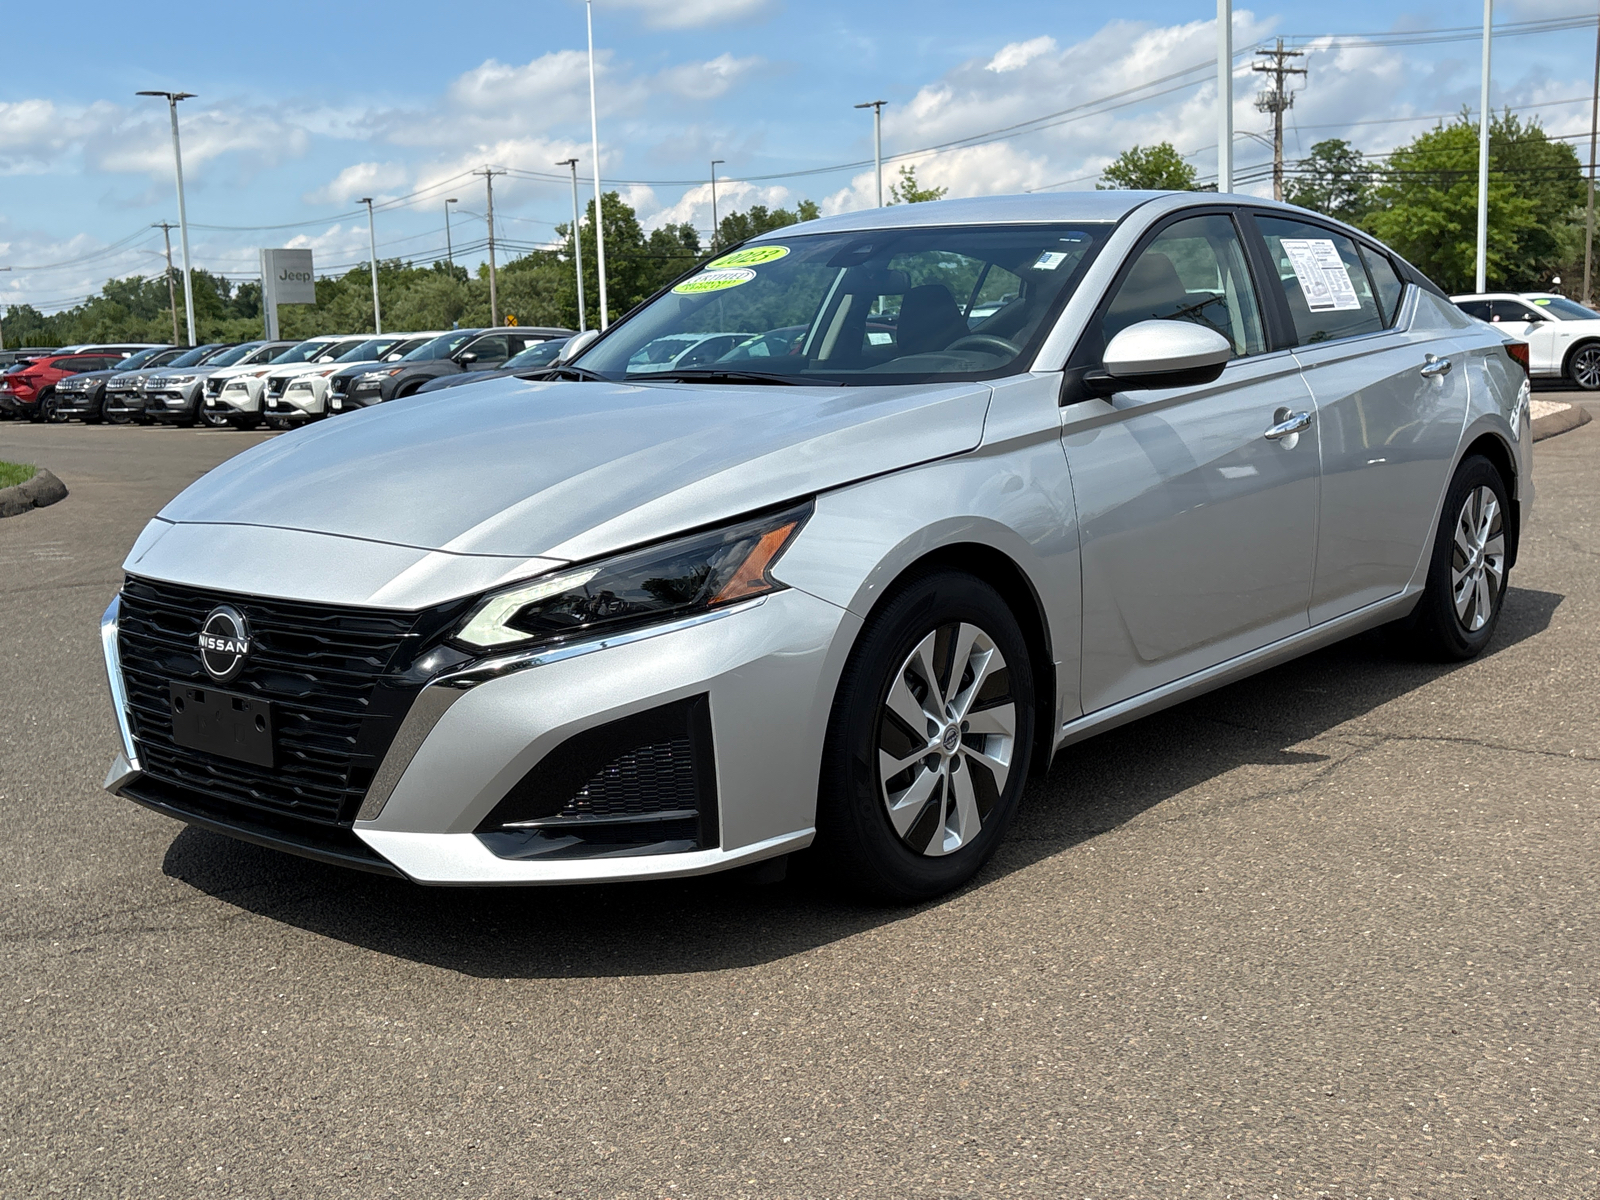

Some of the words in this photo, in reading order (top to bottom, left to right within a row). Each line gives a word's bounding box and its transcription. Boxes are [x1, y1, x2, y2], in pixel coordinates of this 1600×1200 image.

[713, 249, 780, 267] 2023
[279, 268, 311, 283] Jeep
[198, 634, 248, 653] NISSAN
